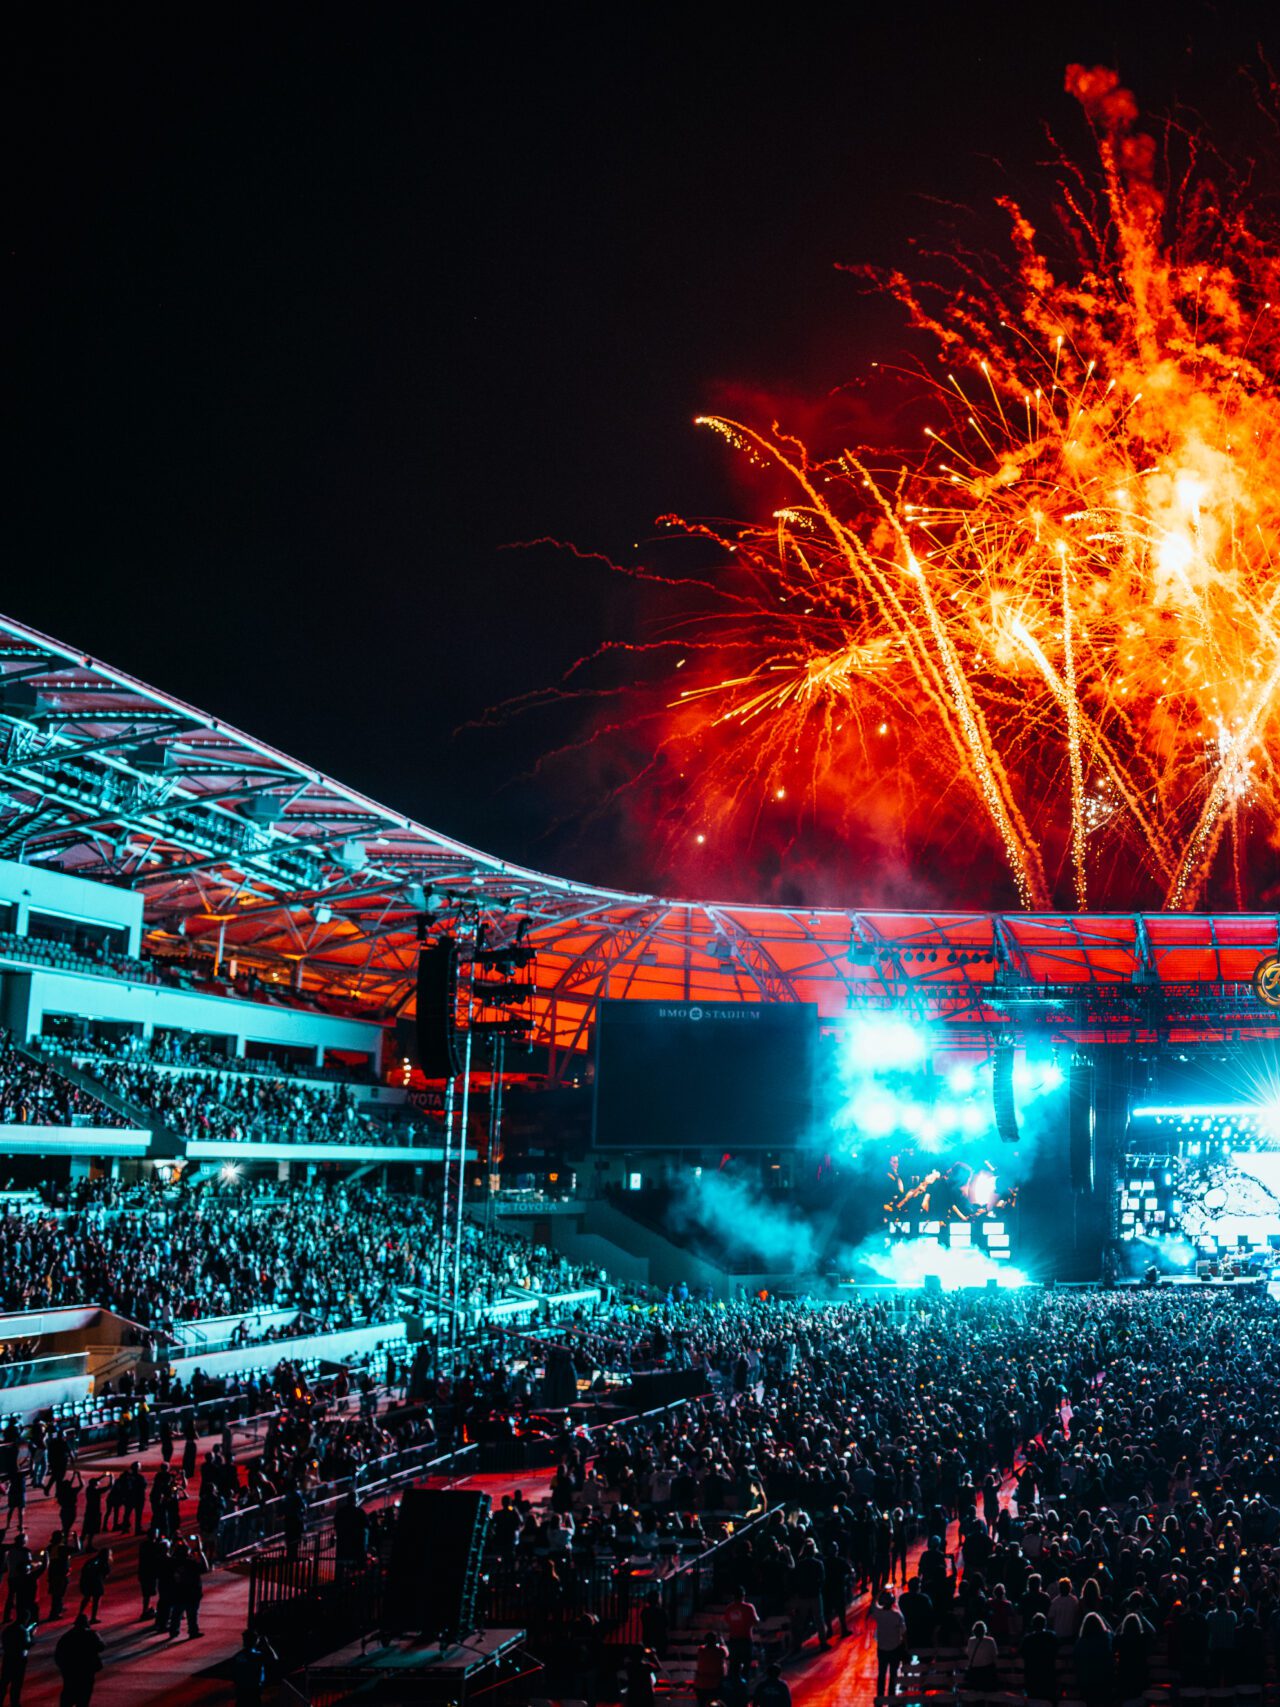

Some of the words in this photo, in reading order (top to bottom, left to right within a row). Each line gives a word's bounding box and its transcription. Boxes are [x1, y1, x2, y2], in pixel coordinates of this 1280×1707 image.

[659, 1008, 687, 1017] BMO
[704, 1009, 760, 1019] STADIUM
[512, 1201, 558, 1212] TOYOTA
